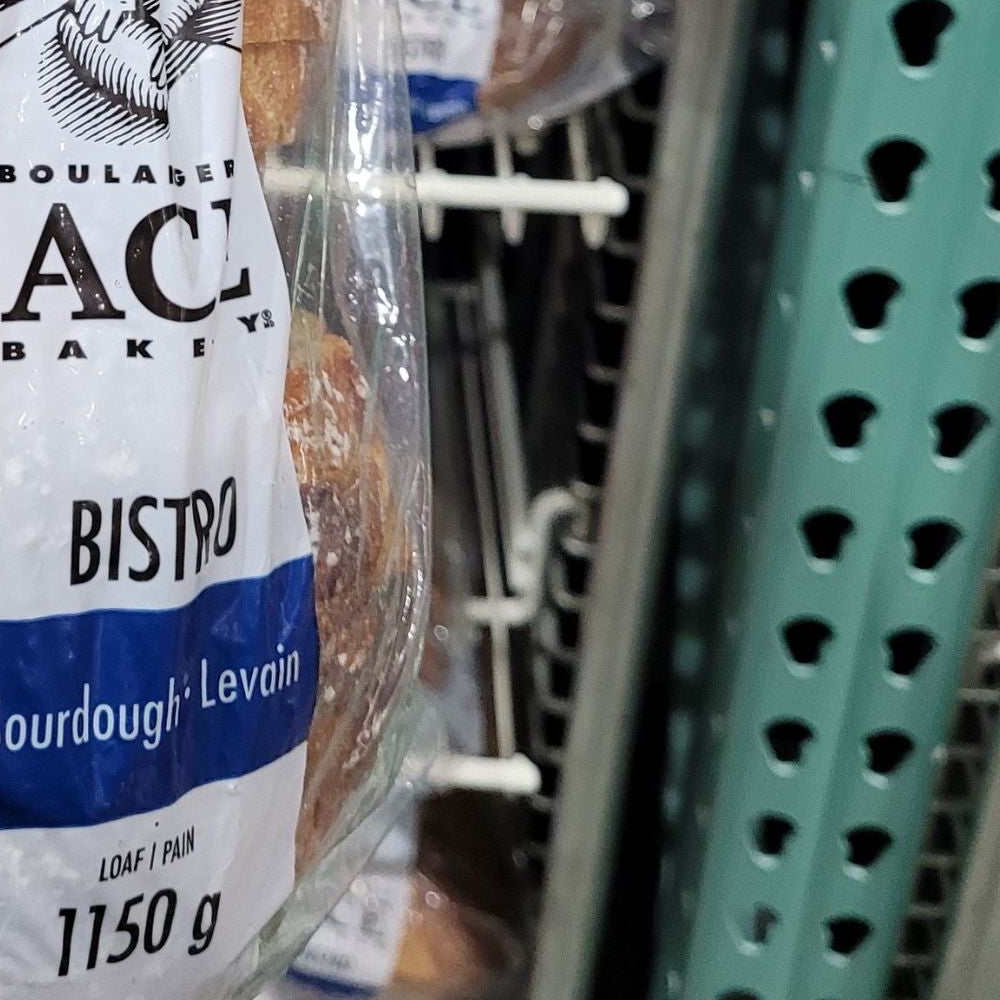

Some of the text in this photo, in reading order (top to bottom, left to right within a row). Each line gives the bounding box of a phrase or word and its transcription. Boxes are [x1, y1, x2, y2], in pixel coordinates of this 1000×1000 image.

[70, 476, 237, 586] BISTRO
[200, 642, 300, 709] Levain
[98, 846, 146, 882] LOAF
[161, 825, 196, 866] PAIN
[57, 887, 222, 977] 1150 g
